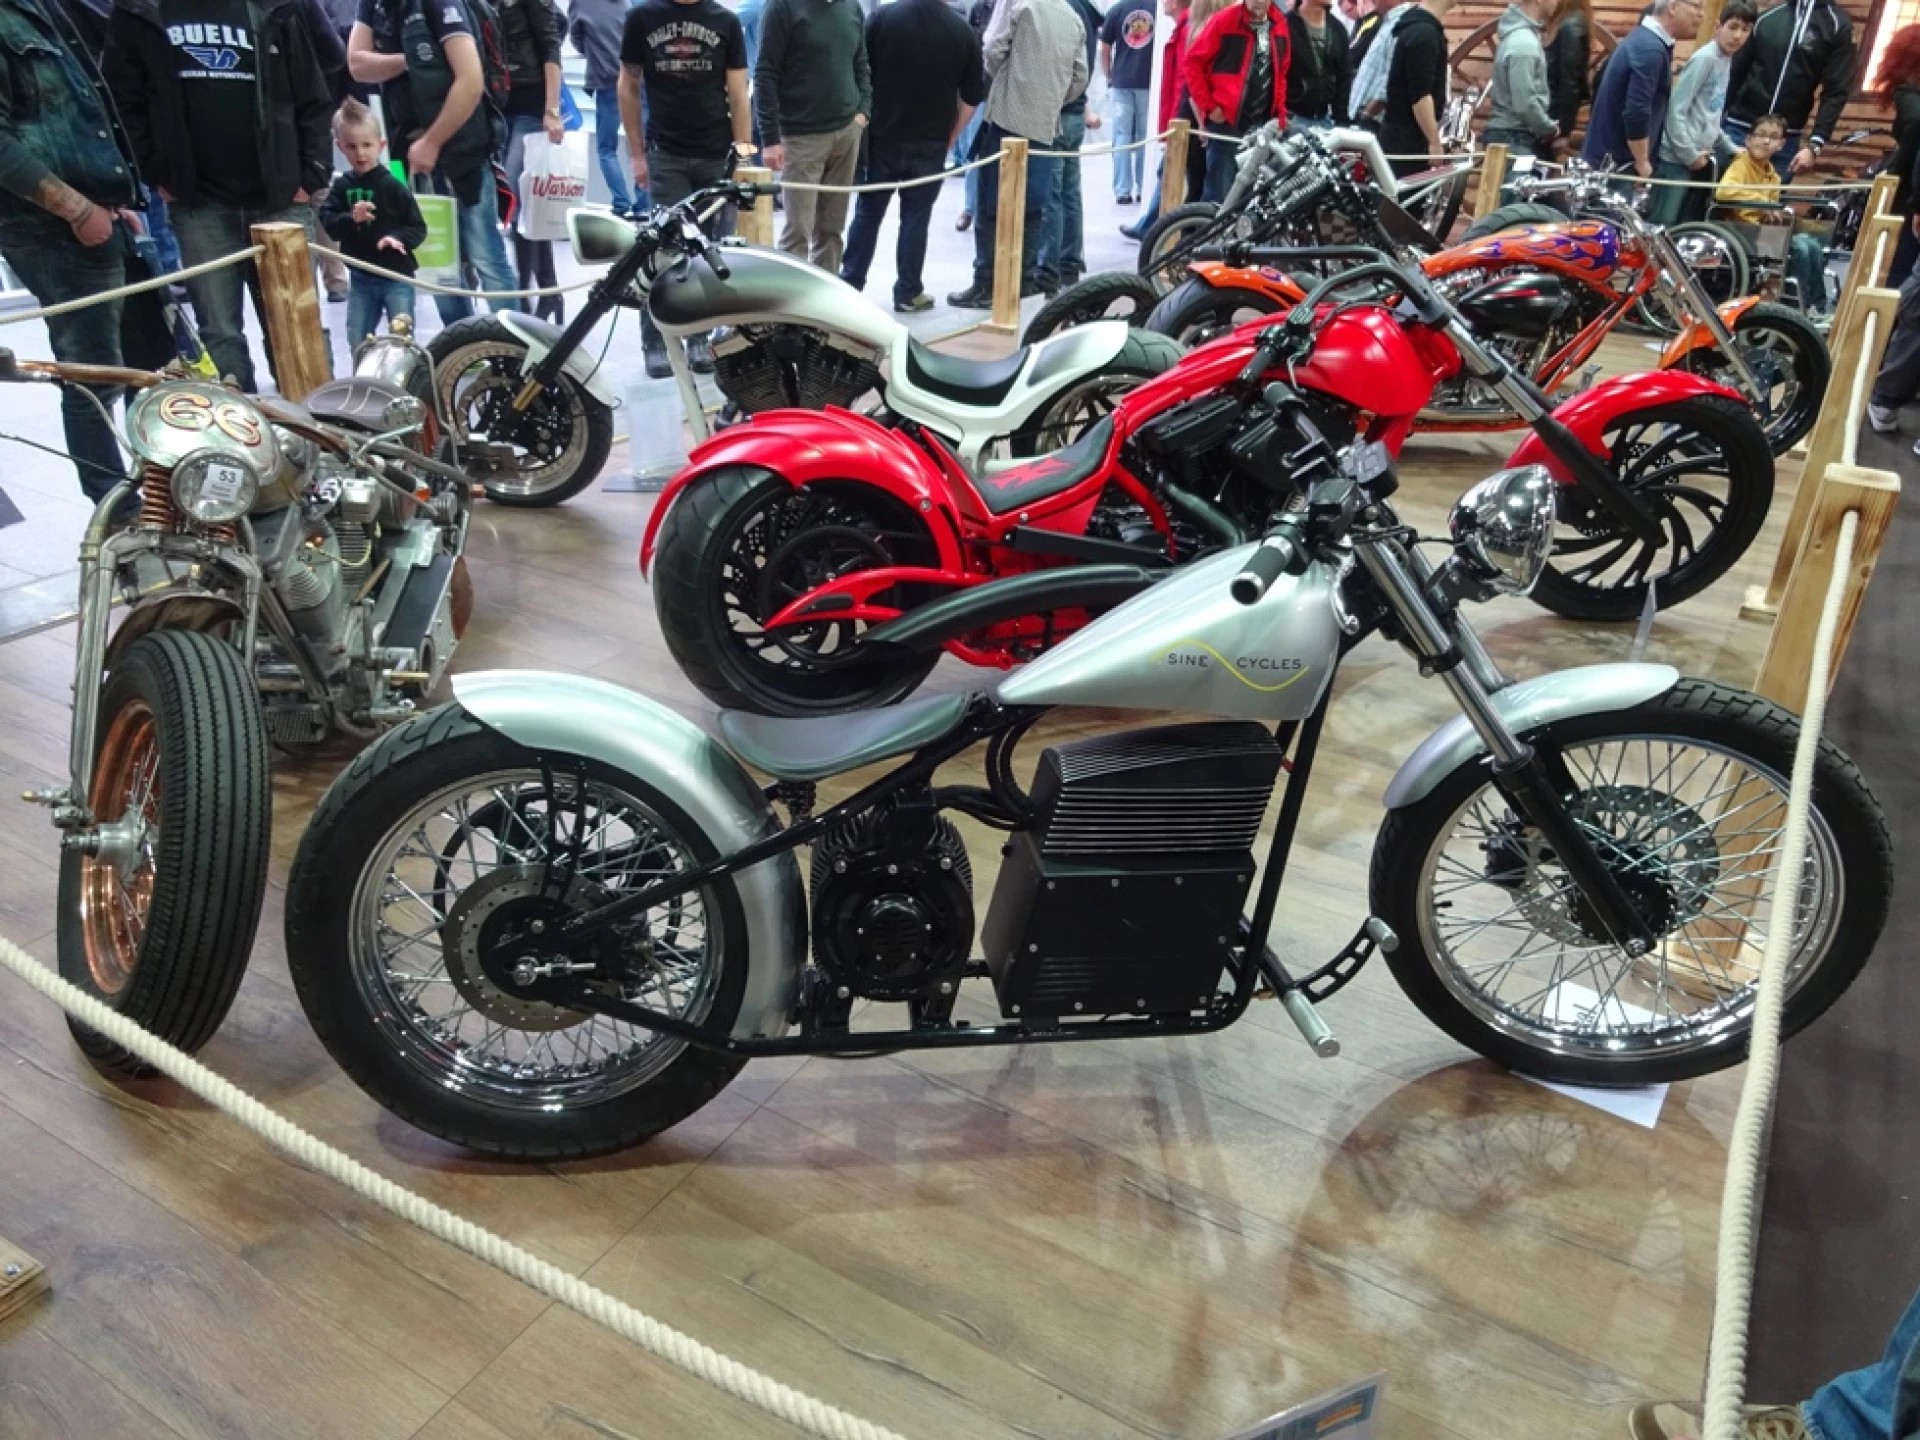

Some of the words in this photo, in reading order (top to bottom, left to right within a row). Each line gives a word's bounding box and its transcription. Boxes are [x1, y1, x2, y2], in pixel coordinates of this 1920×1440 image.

[166, 23, 254, 50] BUELL
[532, 173, 585, 197] Warson
[219, 470, 236, 483] 53
[1168, 653, 1209, 668] SINE
[1236, 657, 1302, 670] CYCLES
